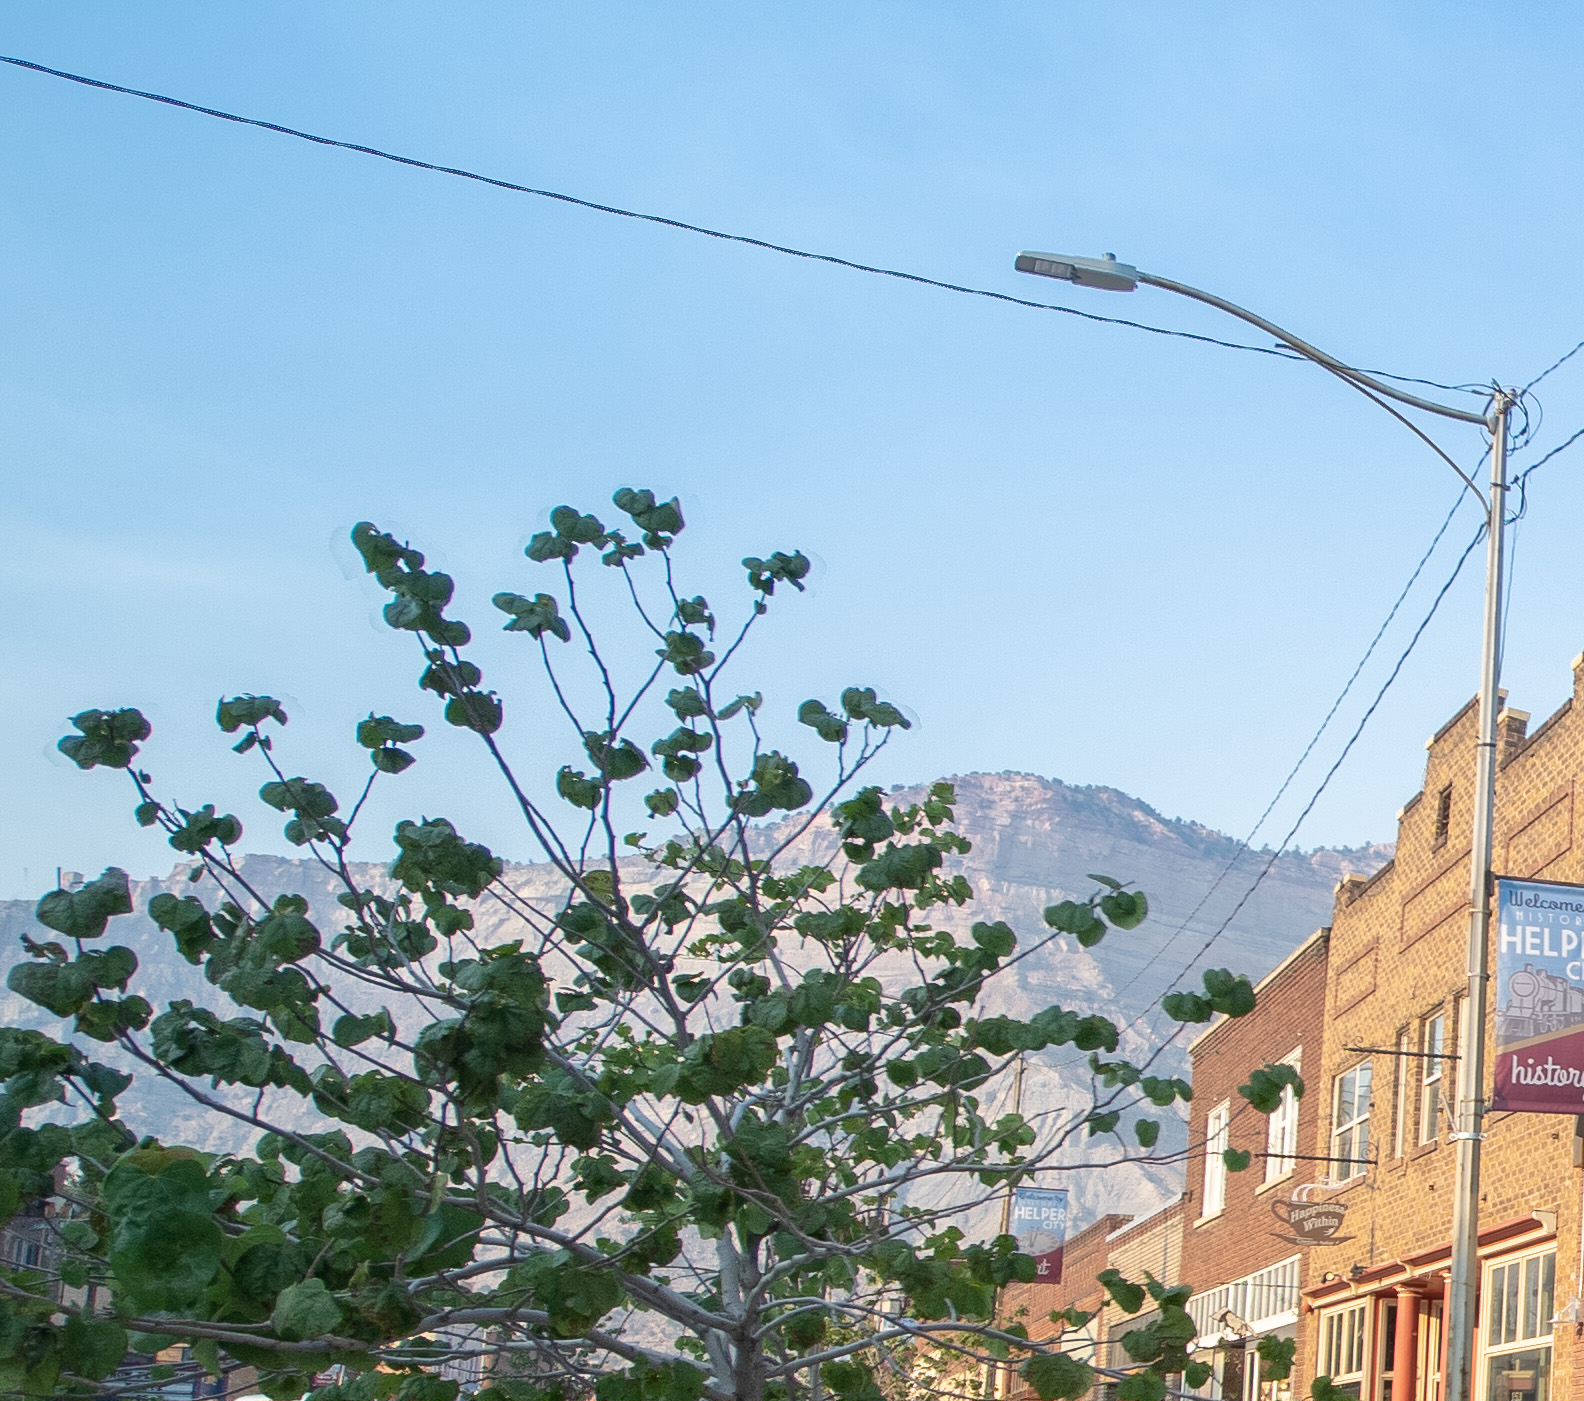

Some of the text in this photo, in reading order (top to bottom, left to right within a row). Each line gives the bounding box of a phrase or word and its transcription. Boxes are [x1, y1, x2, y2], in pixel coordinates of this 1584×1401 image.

[1014, 1206, 1066, 1221] HELPER
[1290, 1203, 1345, 1223] Happiness
[1043, 1220, 1065, 1230] CITY
[1302, 1216, 1339, 1232] Within
